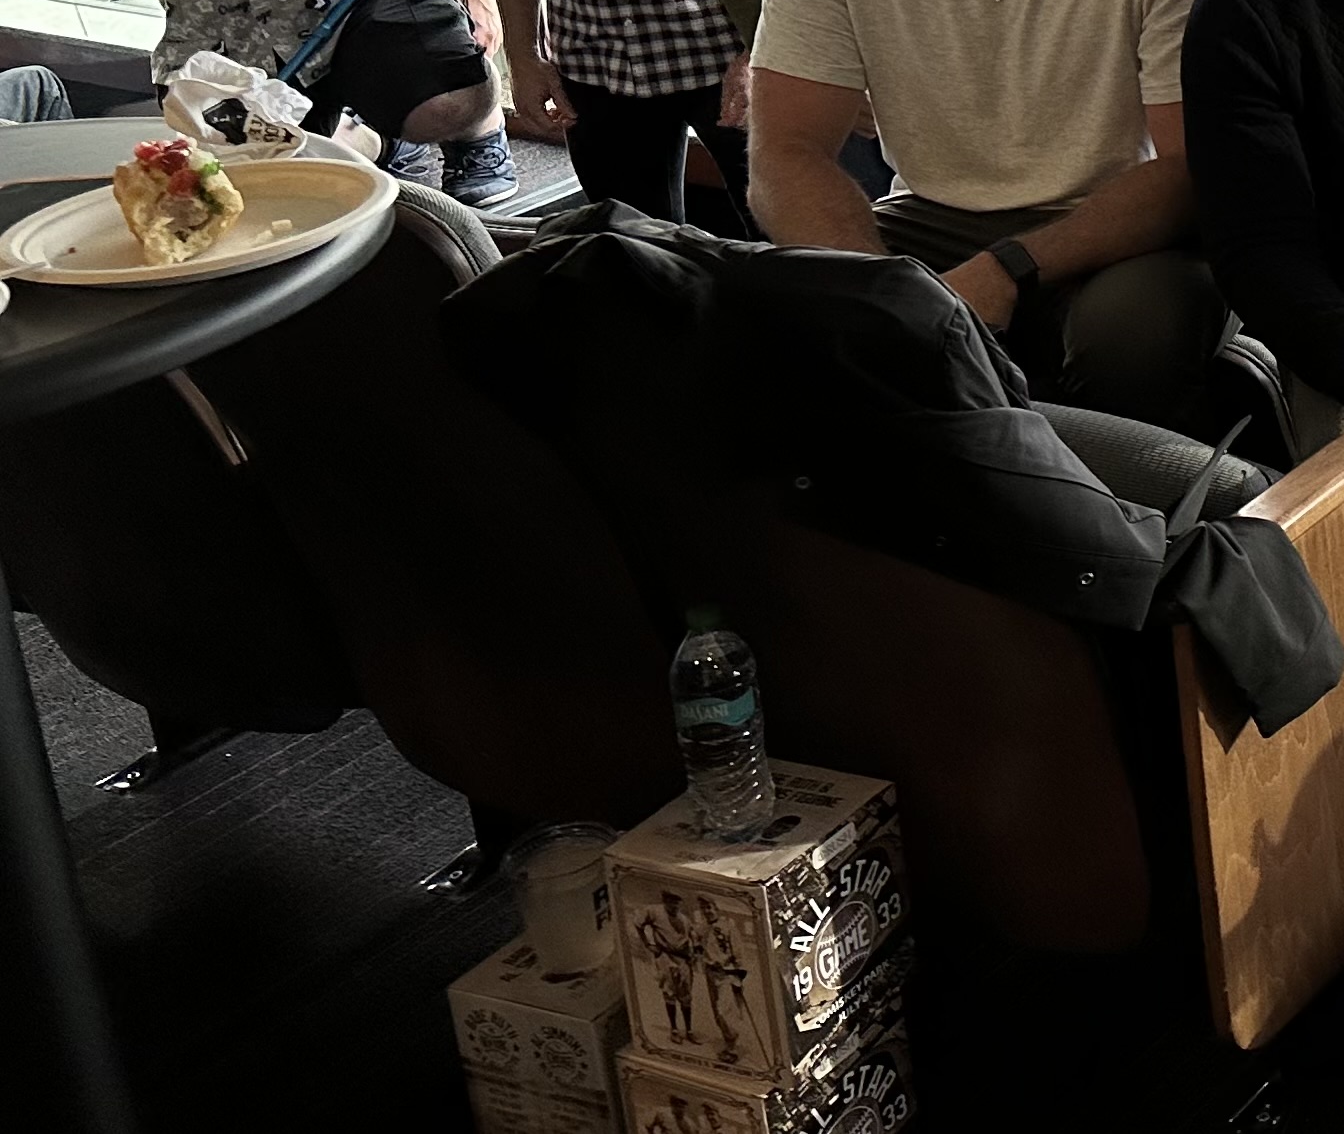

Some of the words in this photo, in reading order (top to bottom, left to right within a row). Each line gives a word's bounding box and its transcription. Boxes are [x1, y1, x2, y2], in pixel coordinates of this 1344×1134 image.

[681, 704, 729, 721] DASANI
[876, 891, 902, 929] 33
[819, 913, 871, 980] GAME
[792, 965, 813, 1002] 19
